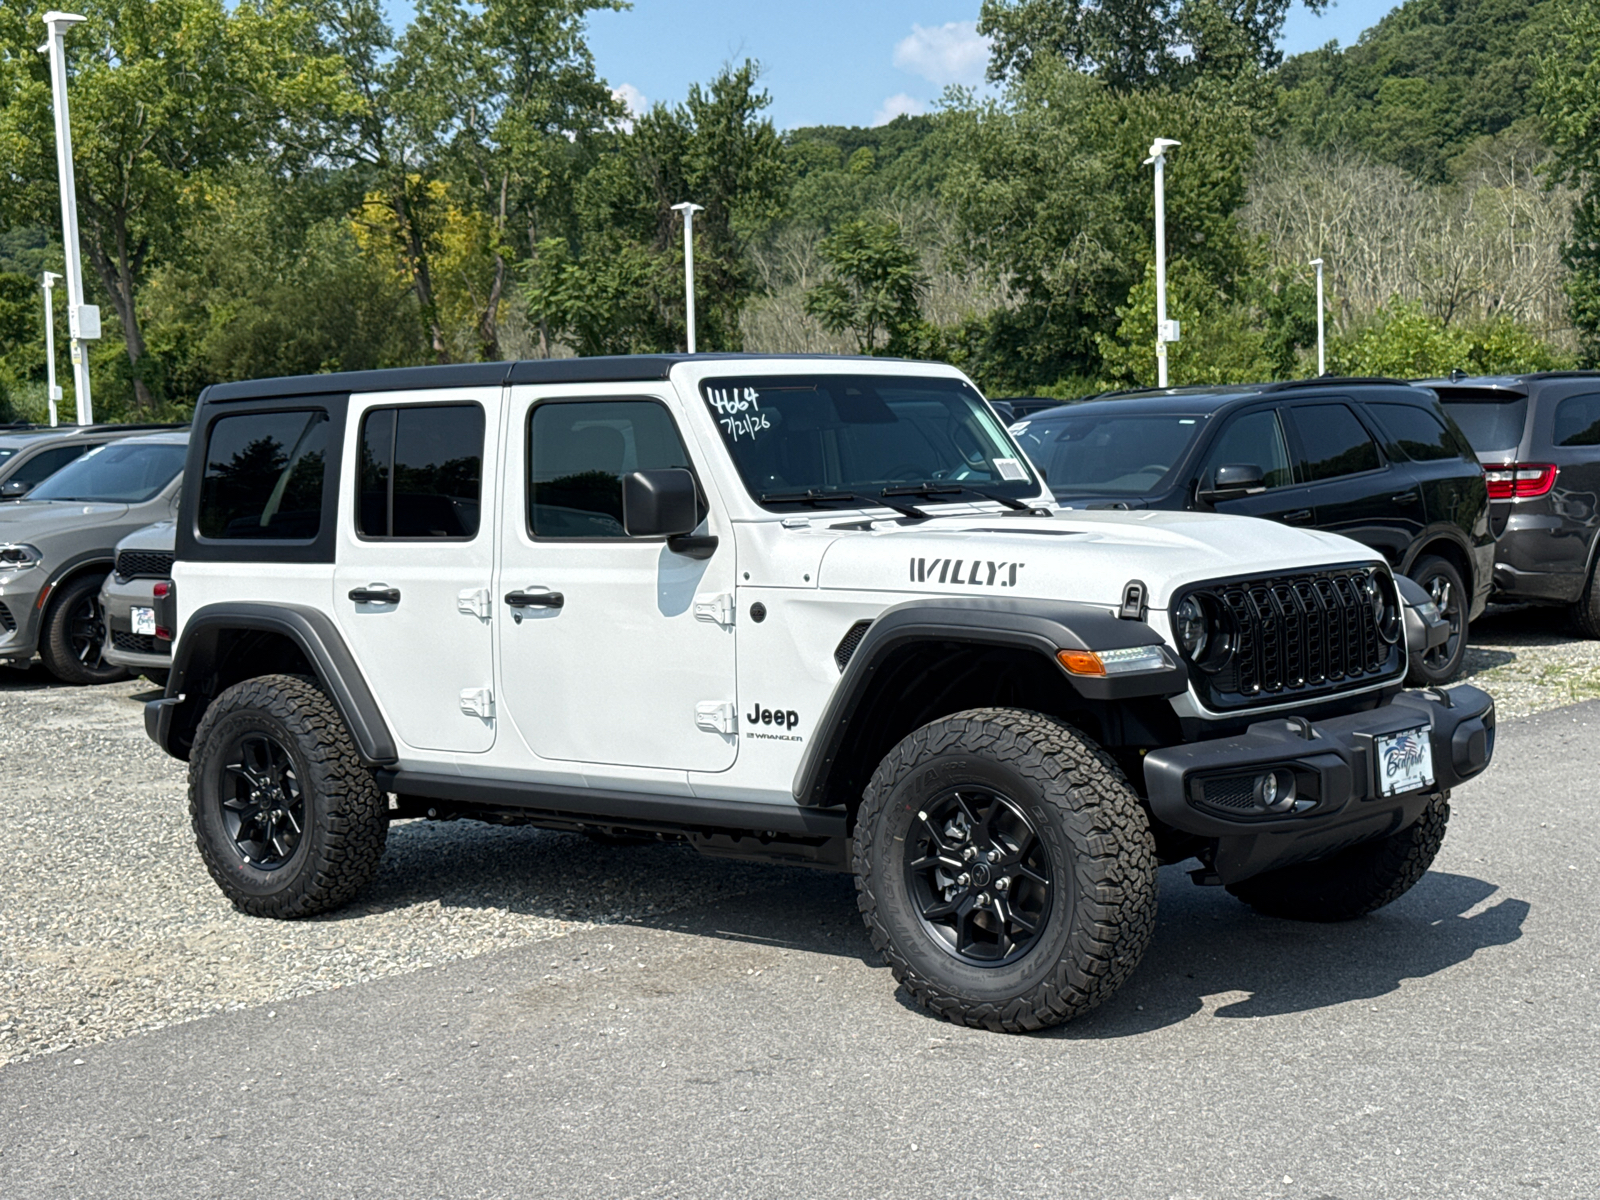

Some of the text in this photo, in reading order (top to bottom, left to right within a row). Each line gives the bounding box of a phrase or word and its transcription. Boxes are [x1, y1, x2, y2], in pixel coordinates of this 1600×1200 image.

[706, 386, 760, 415] 4664
[719, 413, 771, 442] 7/21/26
[909, 557, 1026, 588] WILLYS
[746, 702, 799, 731] Jeep
[754, 733, 803, 742] WRANGLER
